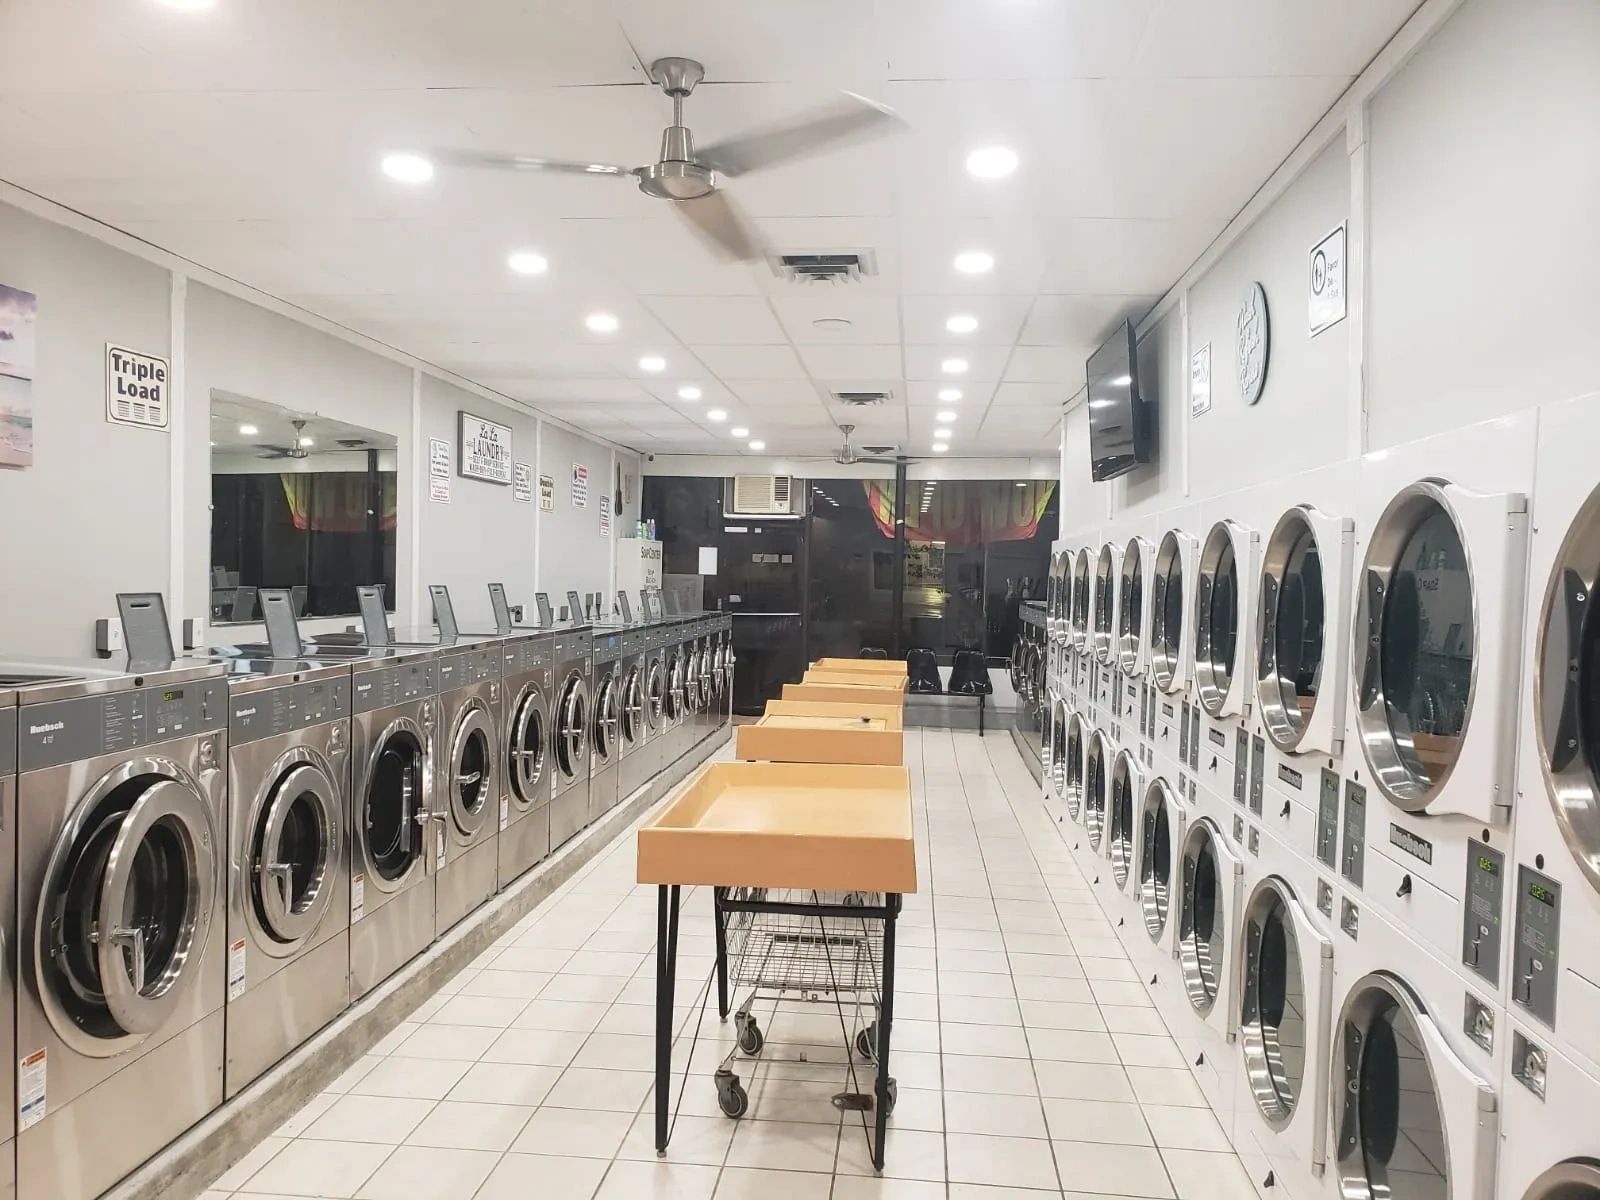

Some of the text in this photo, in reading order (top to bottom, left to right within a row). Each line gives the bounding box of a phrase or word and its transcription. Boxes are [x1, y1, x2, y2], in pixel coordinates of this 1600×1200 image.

[112, 353, 165, 382] Triple
[117, 376, 160, 402] Load
[490, 425, 498, 442] La
[473, 438, 505, 462] LAUNDRY
[541, 487, 552, 498] Load
